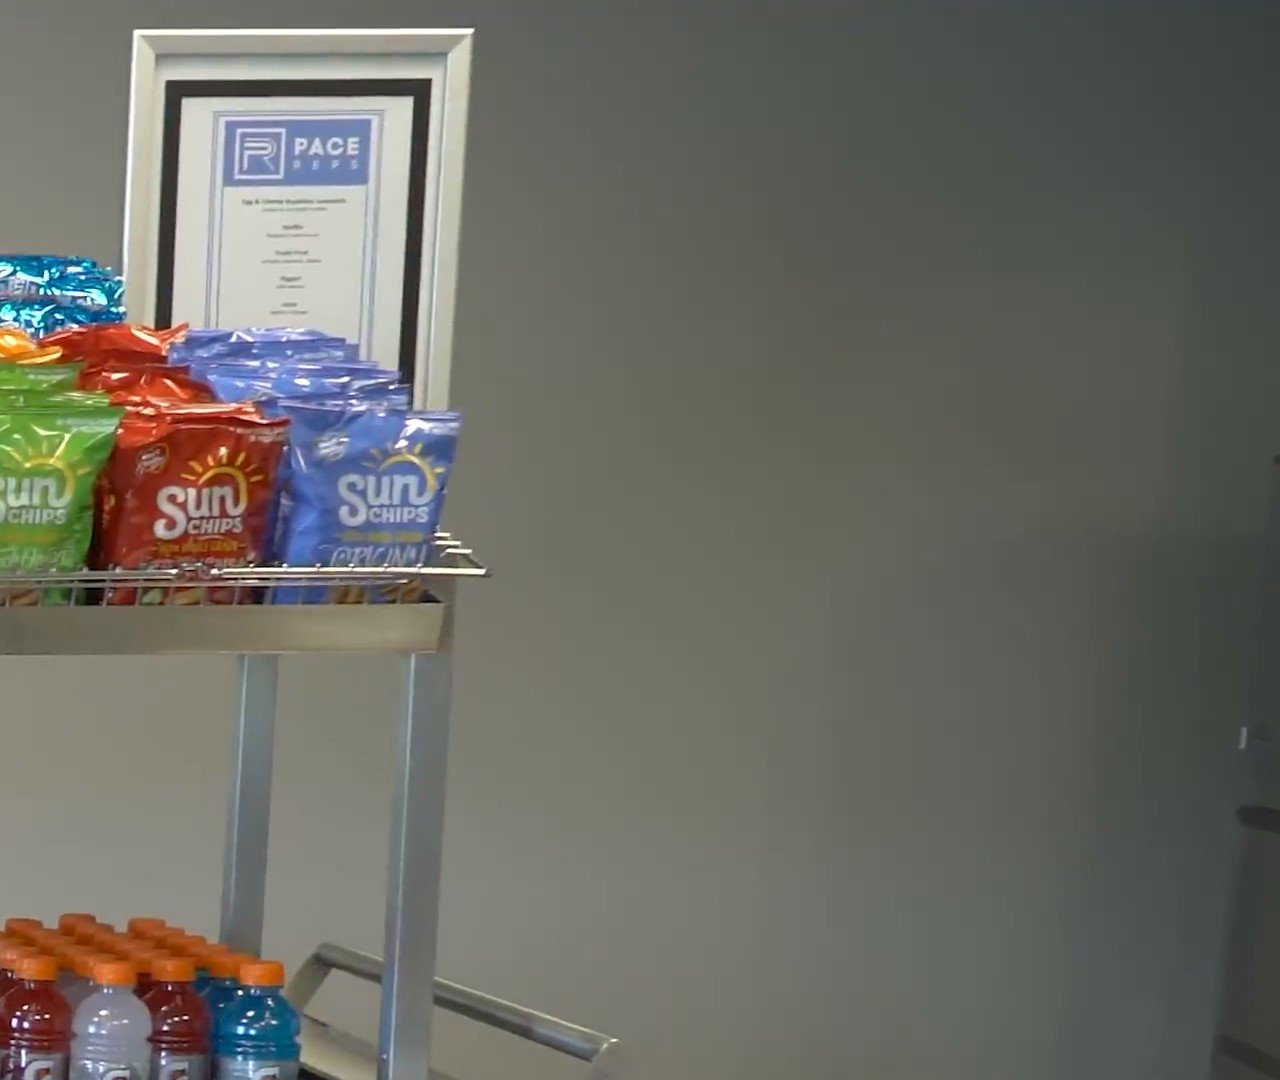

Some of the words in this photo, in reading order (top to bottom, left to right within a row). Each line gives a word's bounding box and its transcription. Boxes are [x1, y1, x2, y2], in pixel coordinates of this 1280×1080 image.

[294, 137, 360, 156] PACE
[337, 474, 436, 528] Sun
[7, 506, 68, 525] CHIPS
[153, 485, 247, 540] Sun
[368, 505, 430, 524] CHIPS
[187, 515, 244, 535] CHIPS
